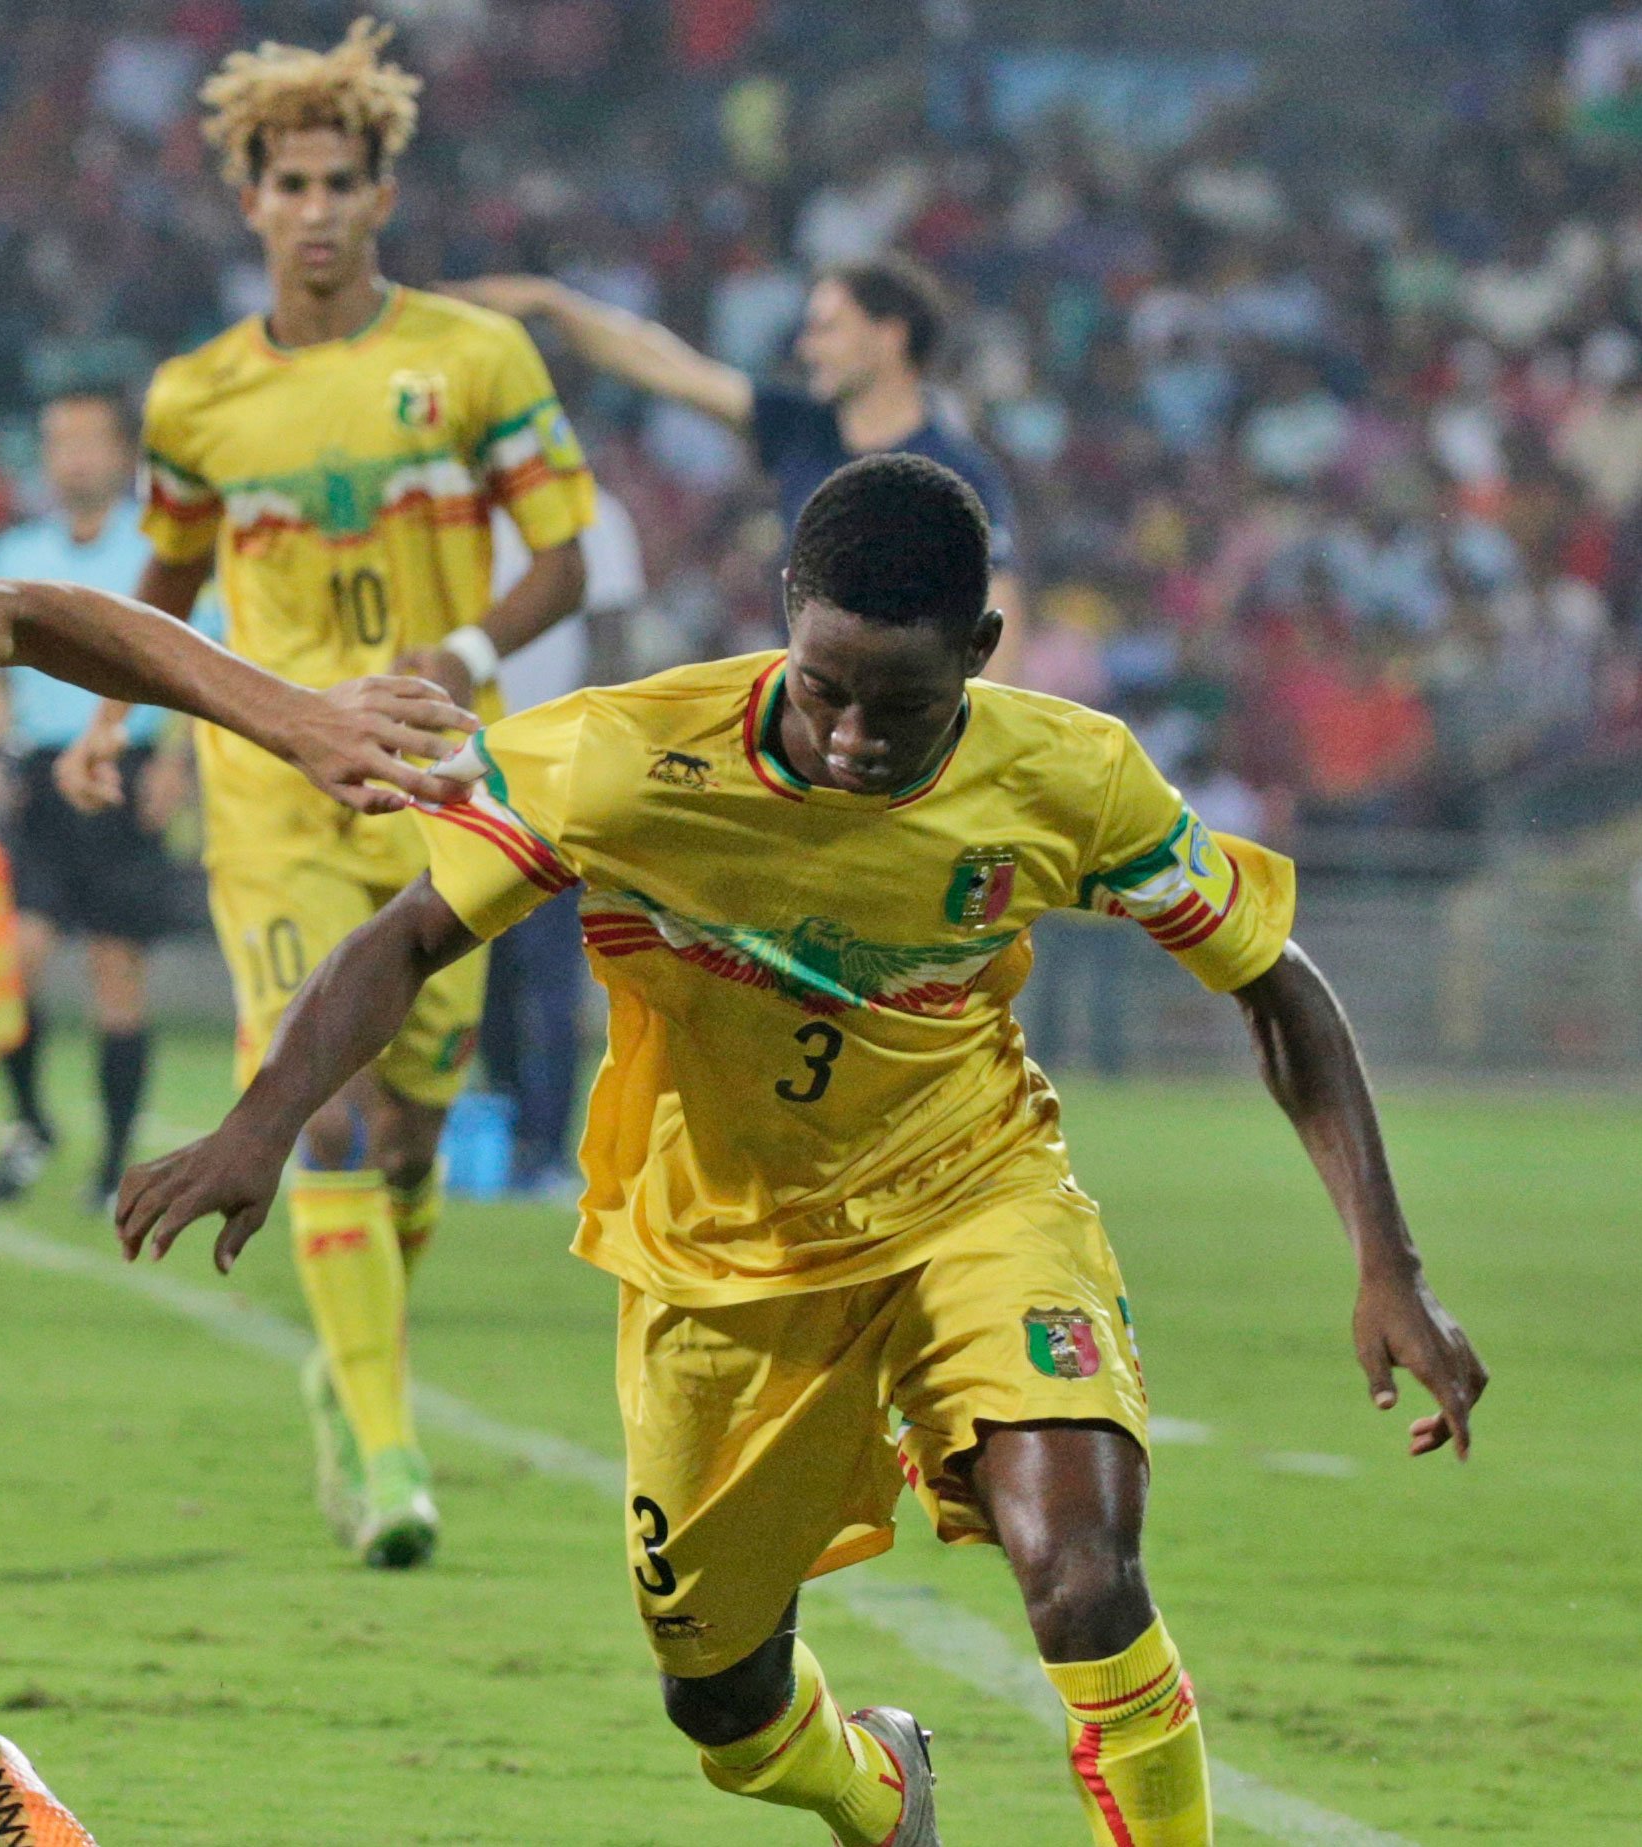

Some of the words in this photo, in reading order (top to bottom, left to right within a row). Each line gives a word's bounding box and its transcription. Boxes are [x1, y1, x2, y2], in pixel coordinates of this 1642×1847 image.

[329, 565, 387, 646] 10
[242, 917, 304, 998] 10
[774, 1021, 843, 1102] 3
[632, 1495, 677, 1596] 3
